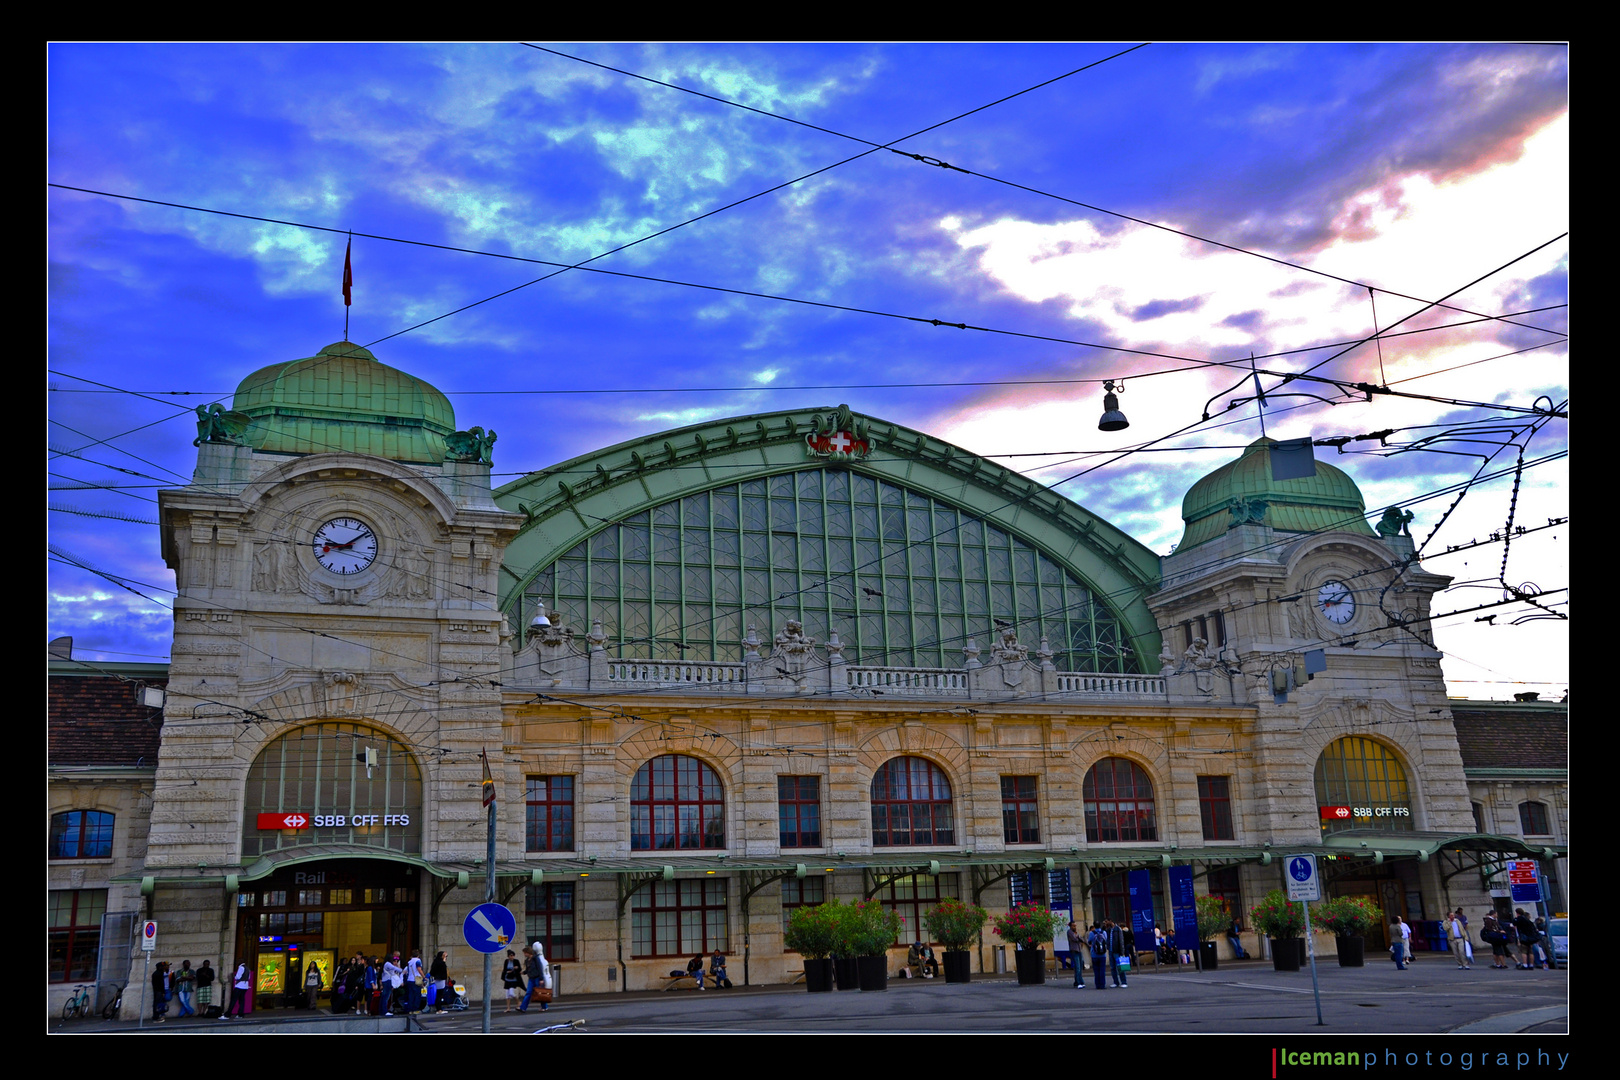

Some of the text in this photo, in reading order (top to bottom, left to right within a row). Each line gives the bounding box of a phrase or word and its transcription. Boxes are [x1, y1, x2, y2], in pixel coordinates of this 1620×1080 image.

[1353, 807, 1410, 817] SBB CFF FFS
[314, 814, 410, 827] SBB CFF FFS
